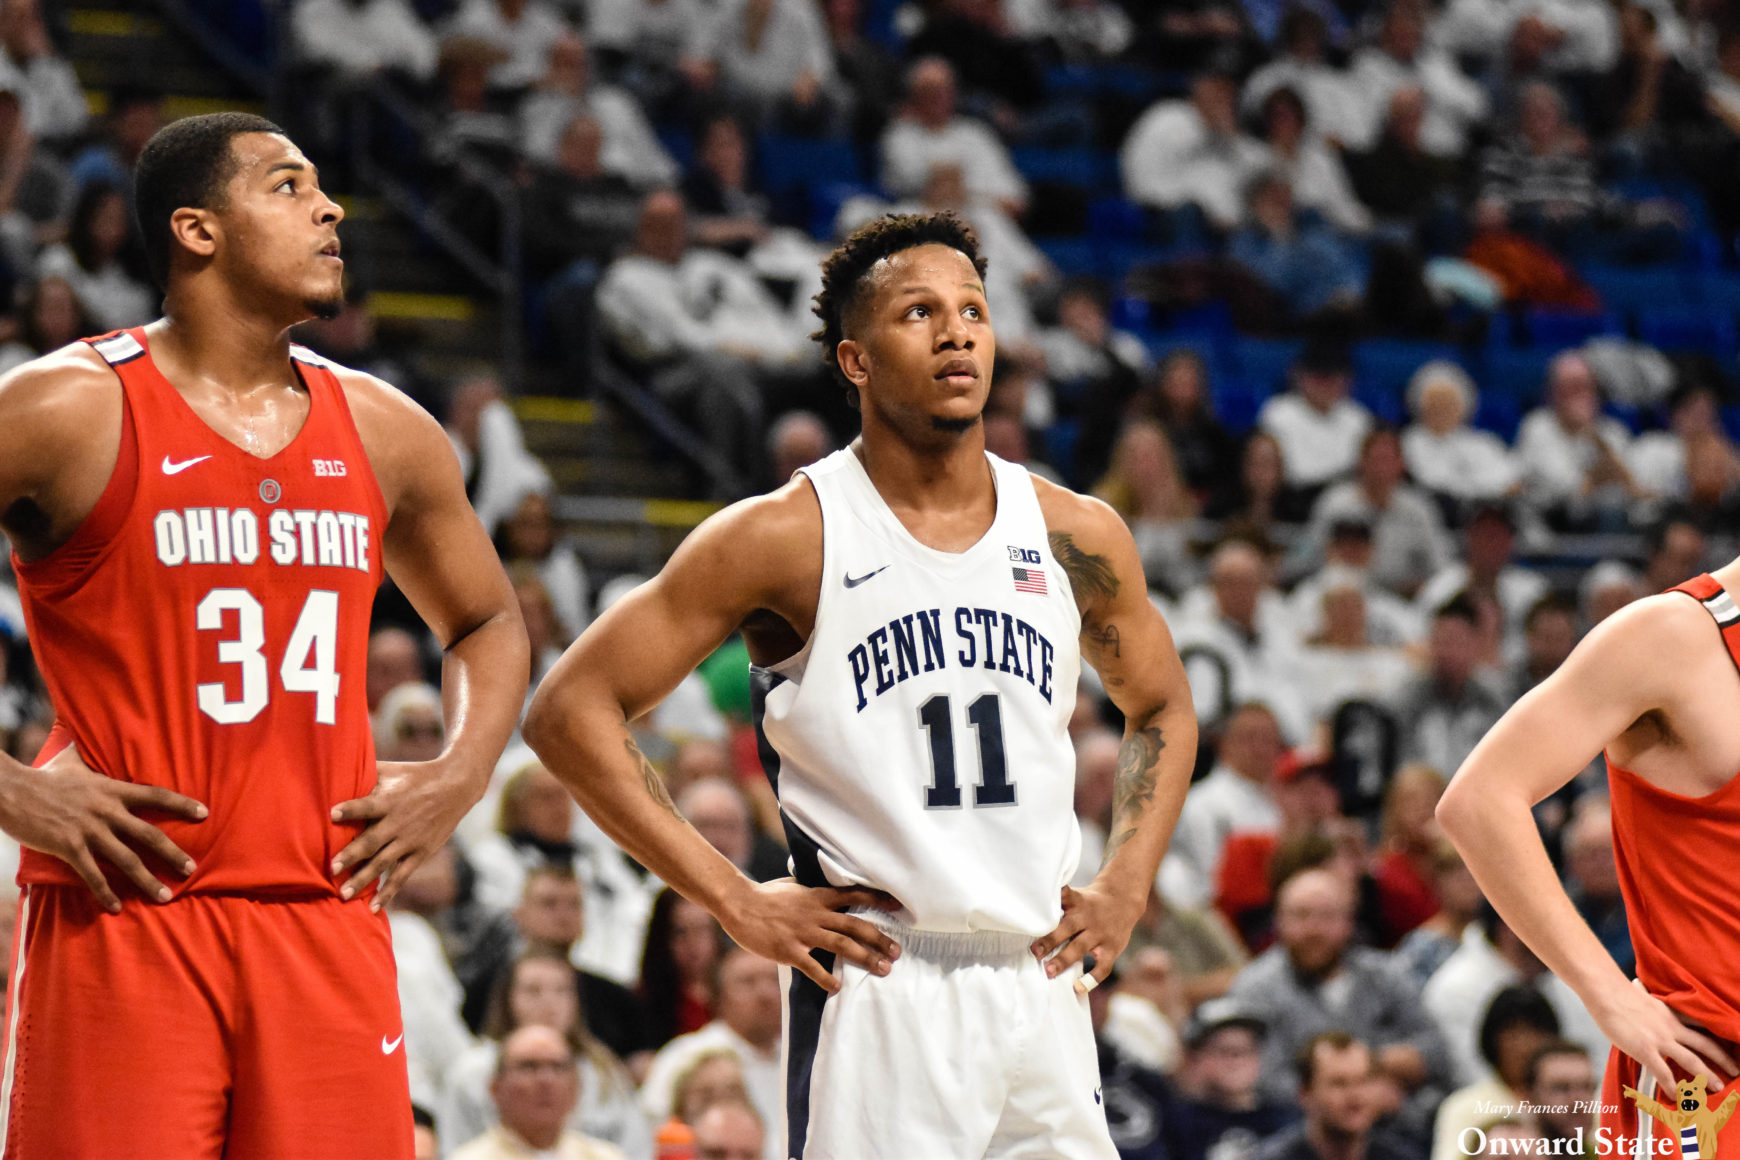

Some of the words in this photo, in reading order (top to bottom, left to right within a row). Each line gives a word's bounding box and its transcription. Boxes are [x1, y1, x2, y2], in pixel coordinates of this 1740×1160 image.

[154, 507, 260, 567] OHIO
[268, 509, 370, 573] STATE
[196, 588, 341, 725] 34
[847, 608, 946, 714] PENN
[954, 606, 1054, 706] STATE
[916, 691, 1019, 810] 11
